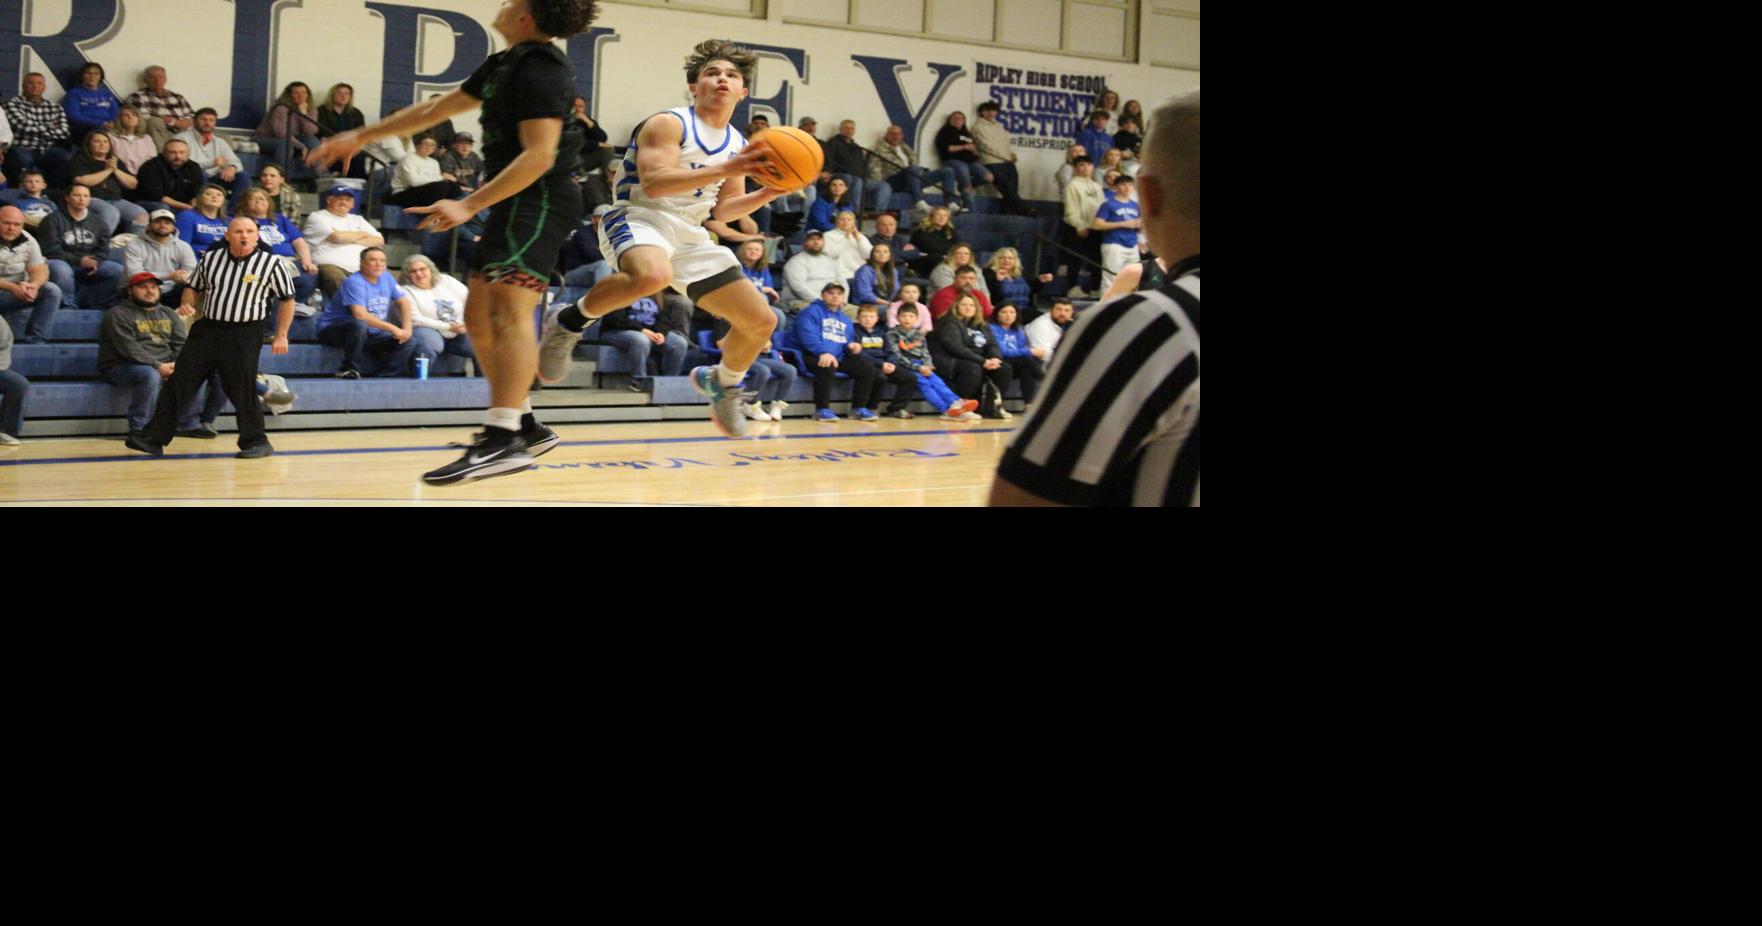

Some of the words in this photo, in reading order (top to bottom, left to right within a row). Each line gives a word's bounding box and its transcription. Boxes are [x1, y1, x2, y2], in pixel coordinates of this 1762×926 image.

[975, 62, 1023, 84] RIPLEY
[1026, 70, 1056, 87] HIGH
[1060, 74, 1107, 94] SCHOOL
[989, 85, 1096, 116] STUDENT
[995, 110, 1084, 138] SECTION
